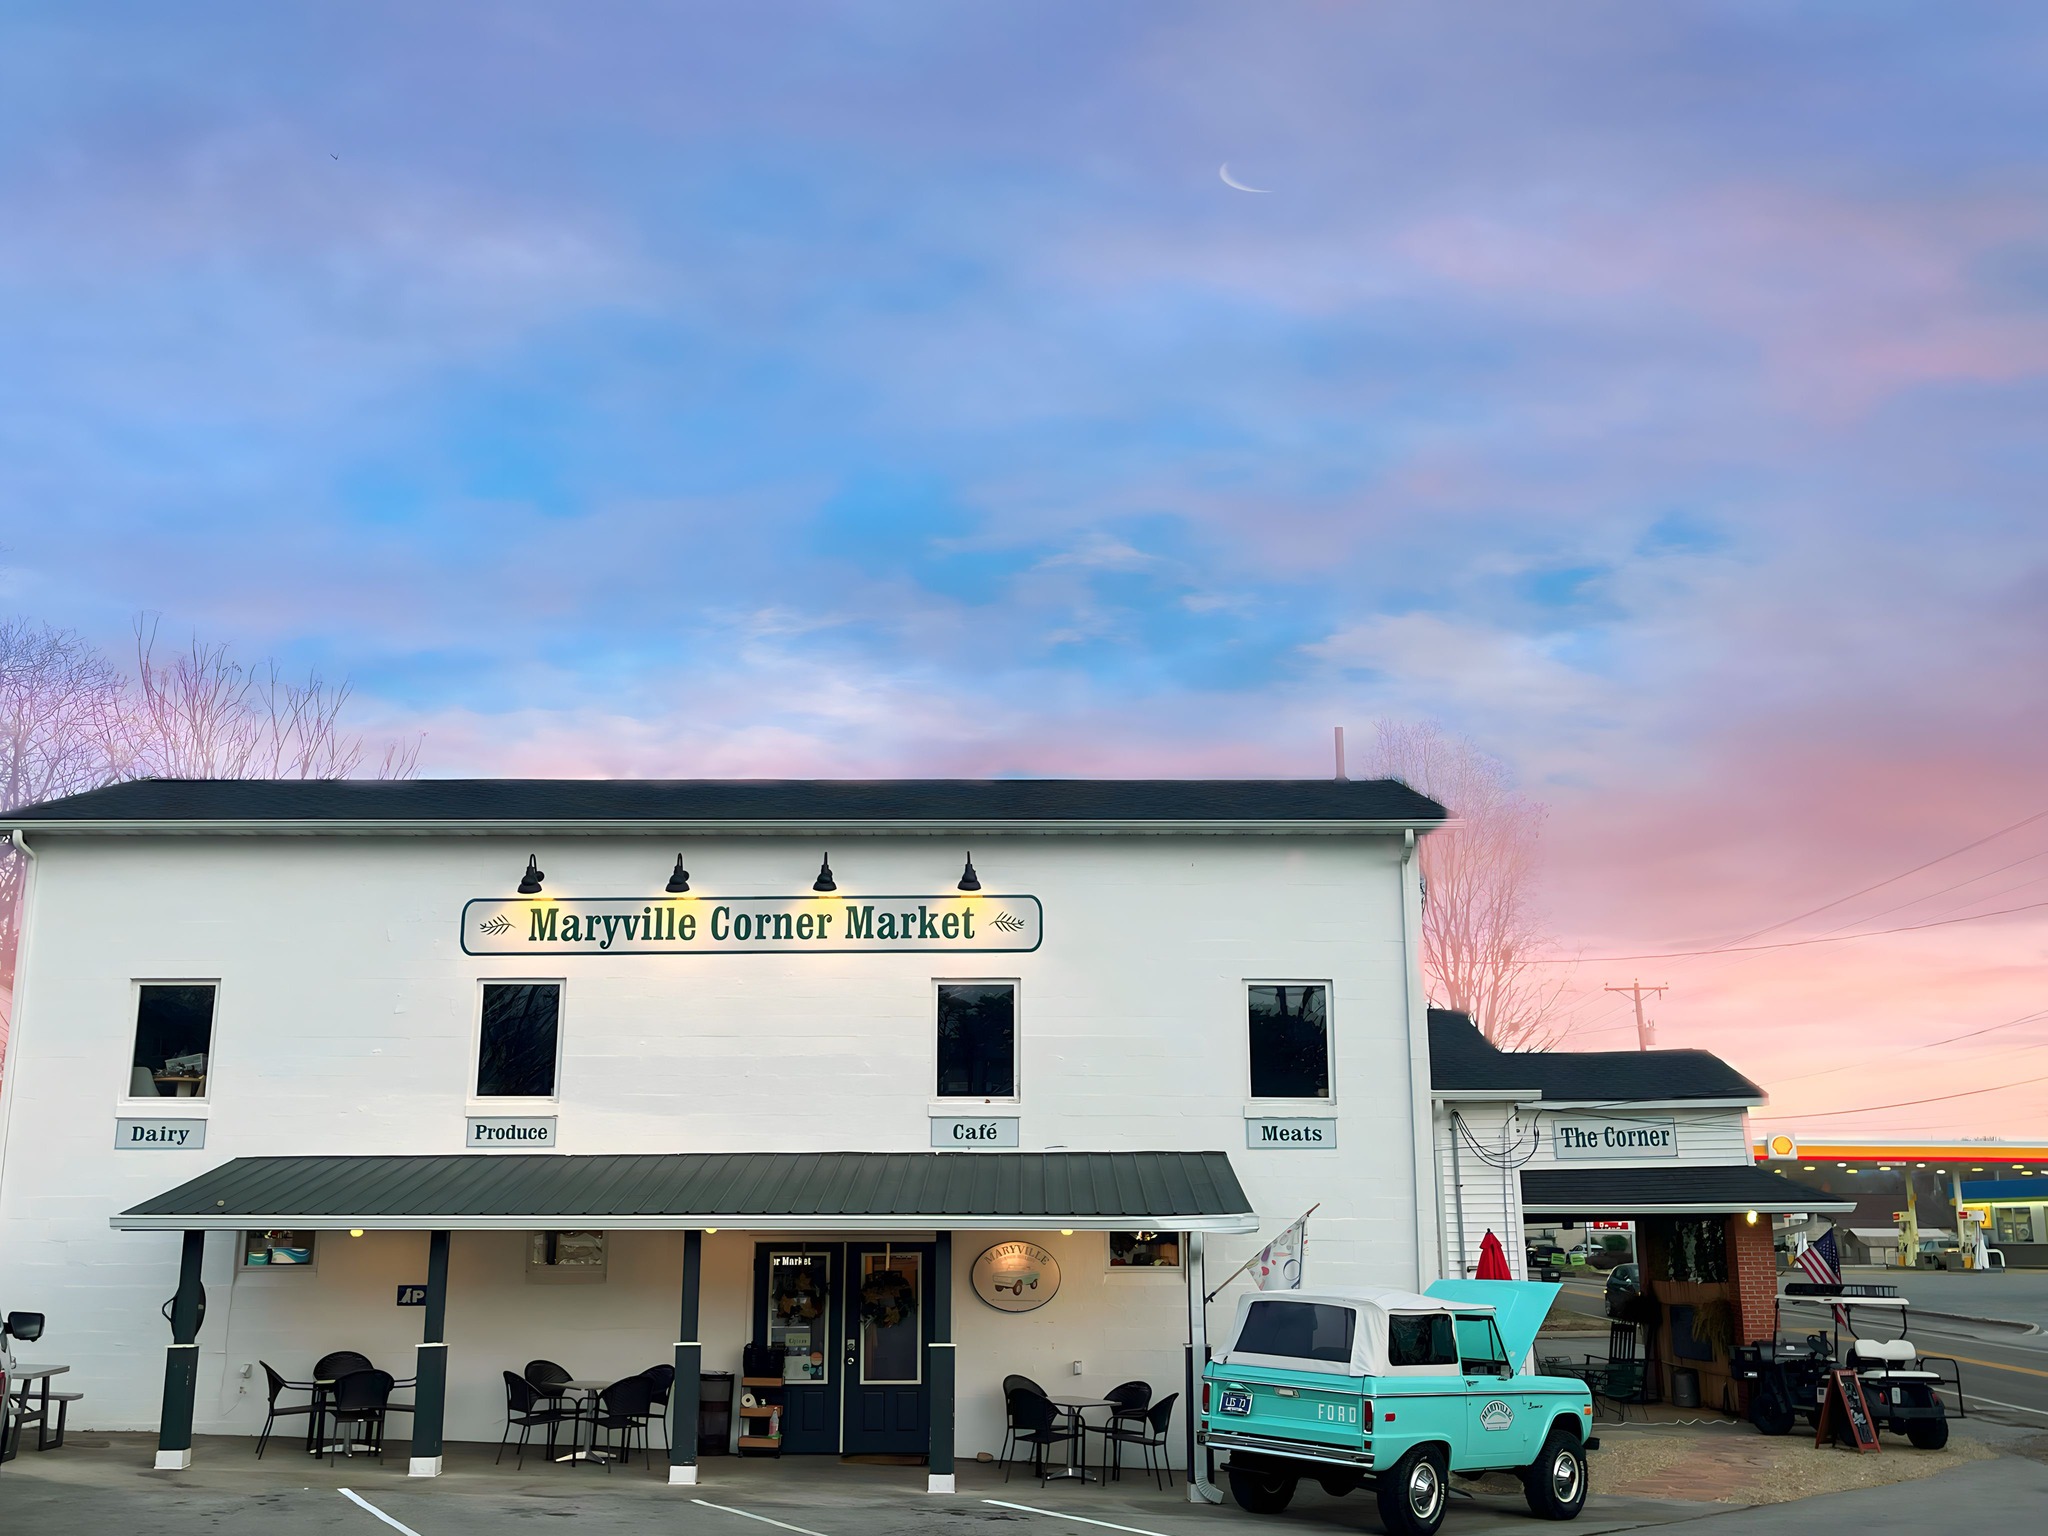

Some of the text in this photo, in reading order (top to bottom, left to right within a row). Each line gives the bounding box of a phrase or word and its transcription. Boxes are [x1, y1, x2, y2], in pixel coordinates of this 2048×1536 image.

[528, 905, 976, 950] Maryville Corner Market
[130, 1125, 190, 1146] Dairy
[474, 1124, 548, 1140] Produce
[952, 1122, 997, 1140] Café
[1261, 1125, 1323, 1142] Meats
[1560, 1126, 1670, 1148] The Corner
[782, 1256, 812, 1266] Market
[985, 1245, 1049, 1265] MARYVILLE
[1318, 1403, 1356, 1423] FORD
